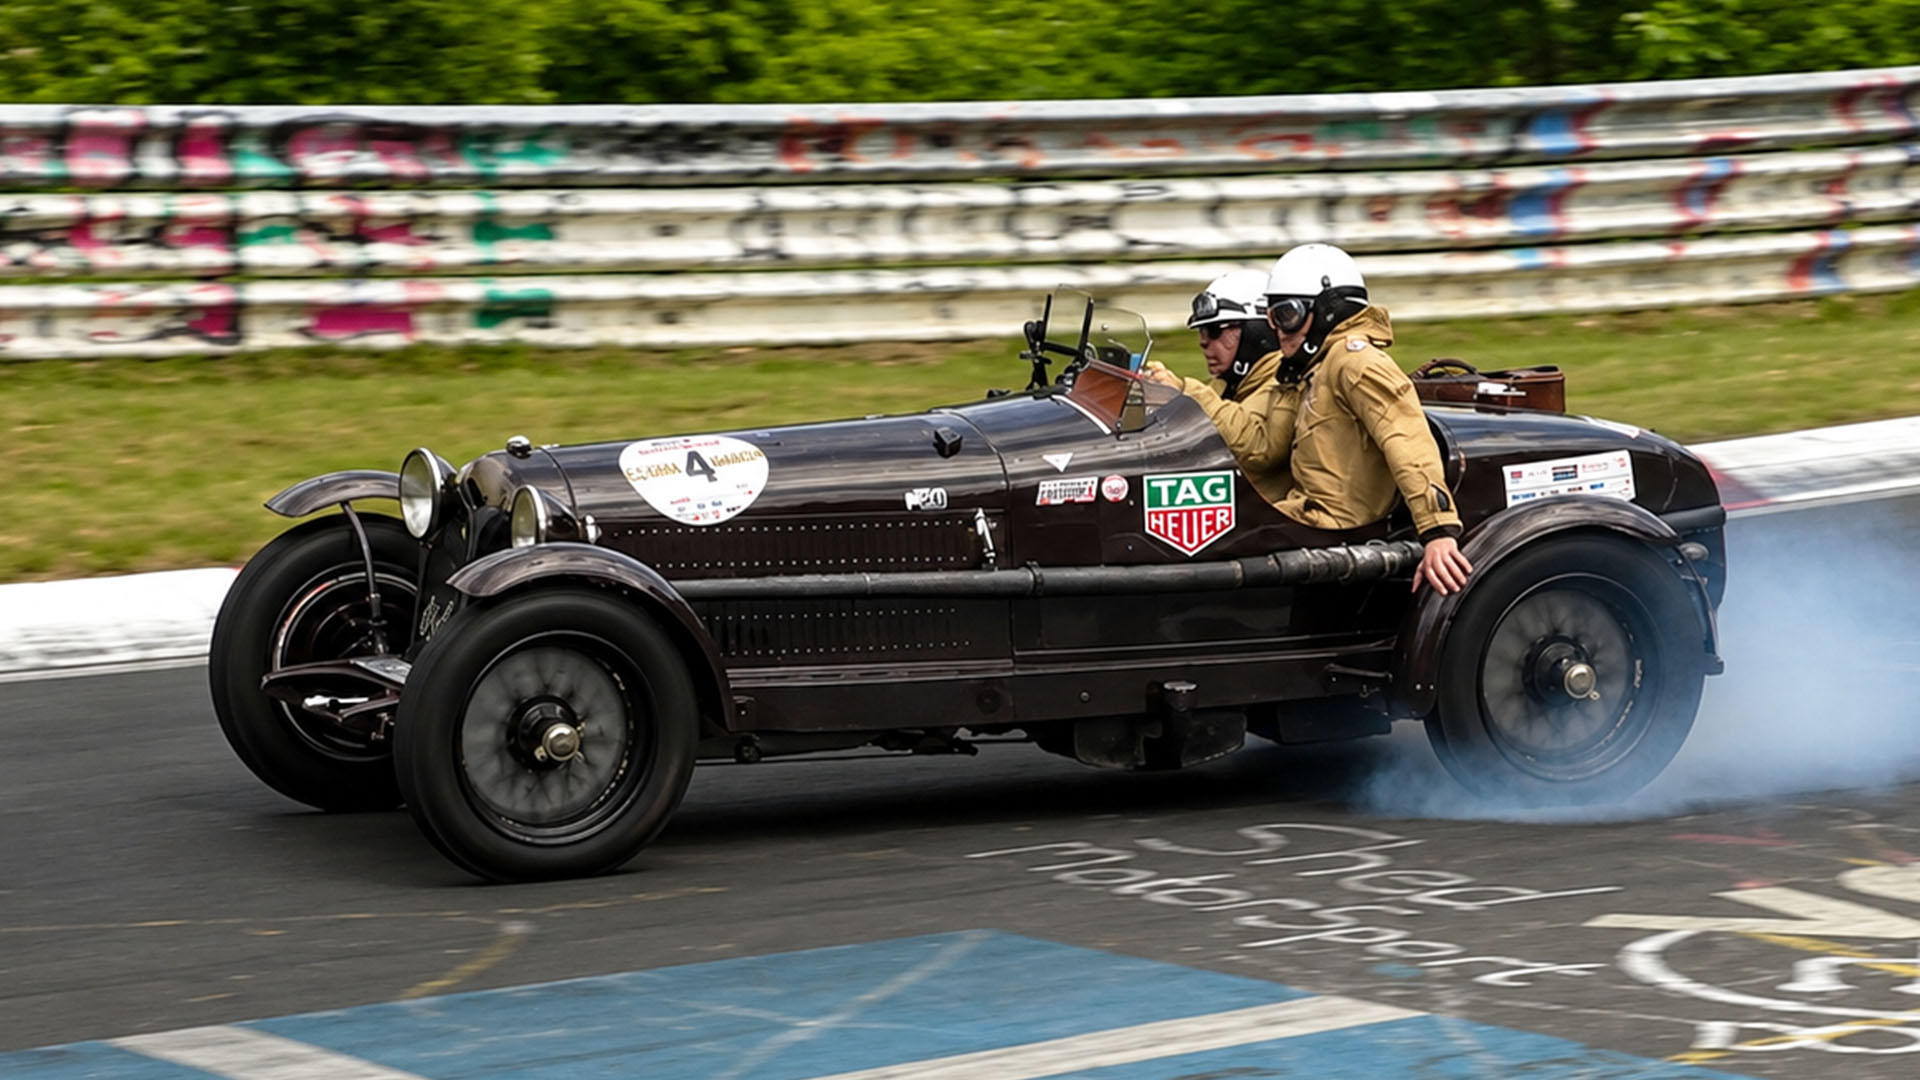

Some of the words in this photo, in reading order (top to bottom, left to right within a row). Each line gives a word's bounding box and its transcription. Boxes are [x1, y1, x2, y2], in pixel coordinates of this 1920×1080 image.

[685, 449, 718, 483] 4
[1150, 476, 1228, 507] TAG
[1149, 508, 1230, 549] HEUER
[1133, 823, 1624, 910] Shed
